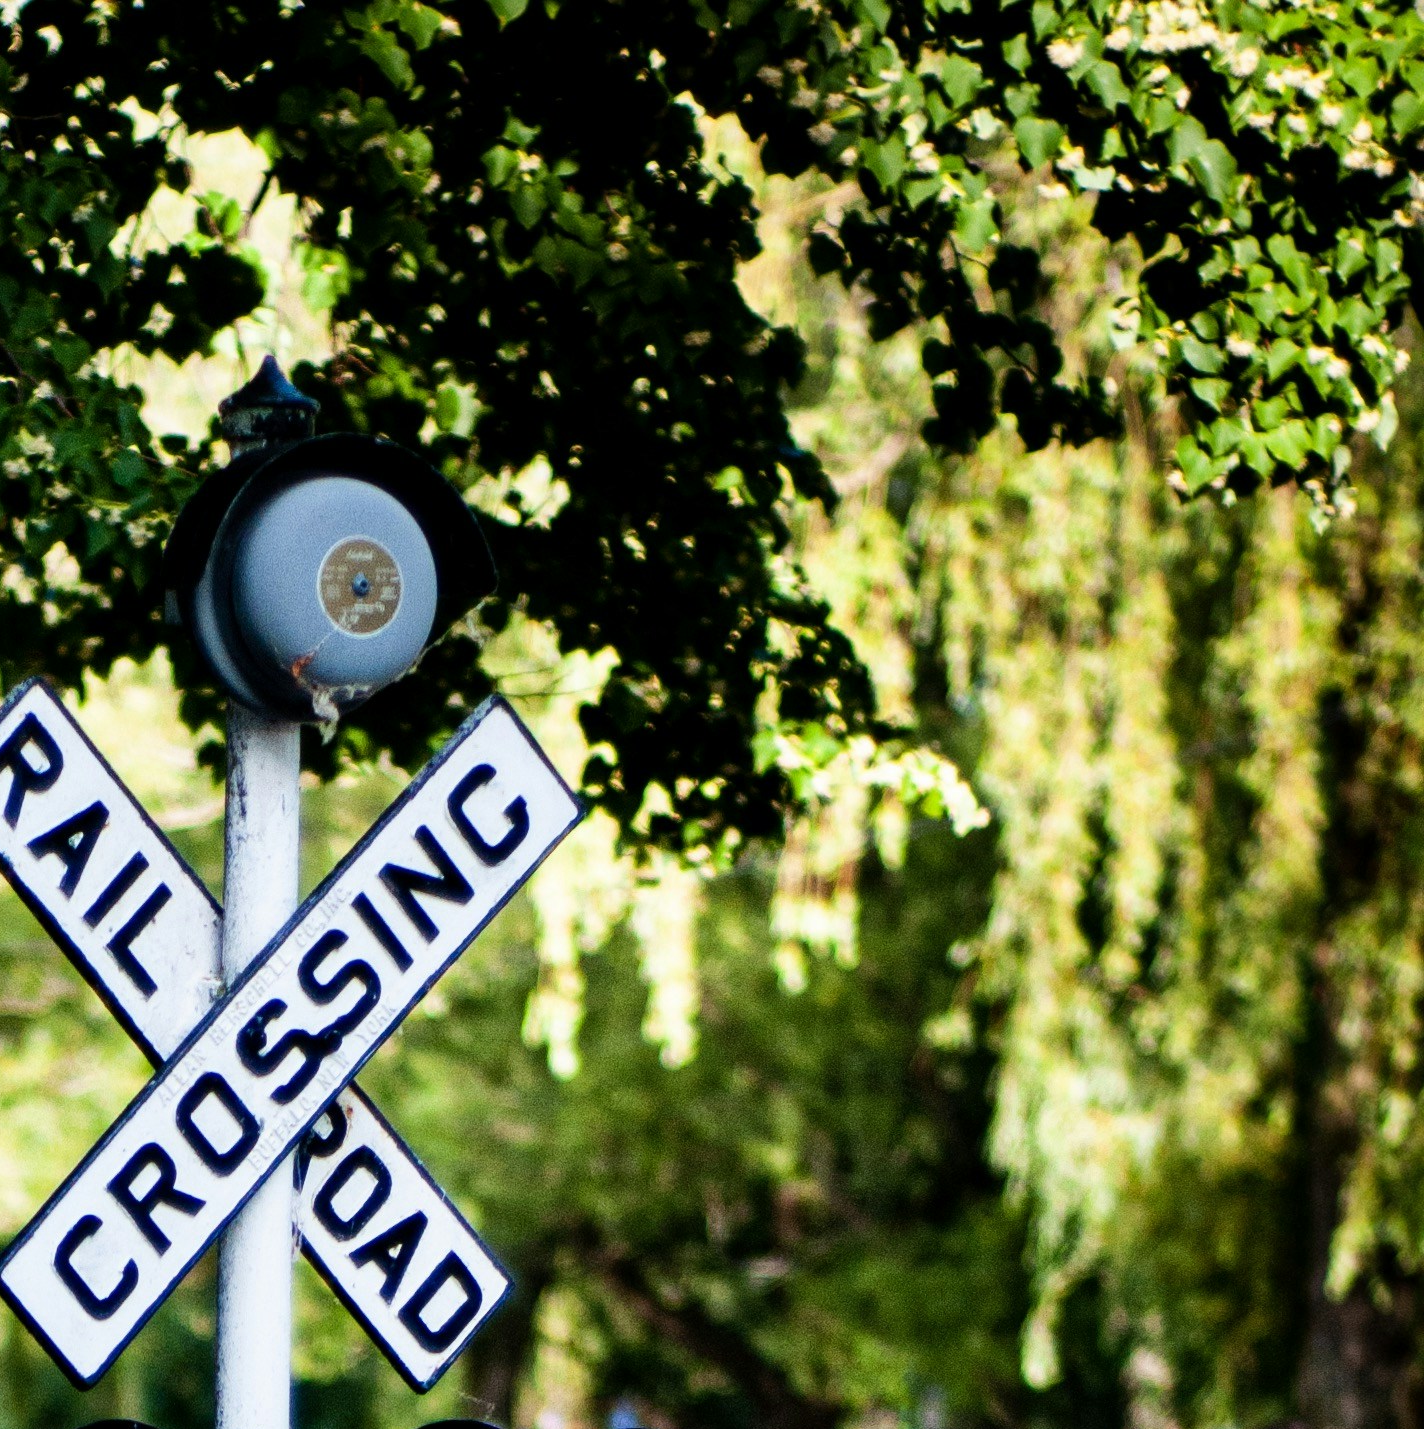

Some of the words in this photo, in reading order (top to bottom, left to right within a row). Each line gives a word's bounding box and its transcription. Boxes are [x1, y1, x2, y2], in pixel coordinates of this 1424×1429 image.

[54, 764, 529, 1320] CROSSING
[316, 1047, 352, 1091] NEW
[355, 997, 396, 1046] YORK
[293, 1098, 484, 1353] ROAD
